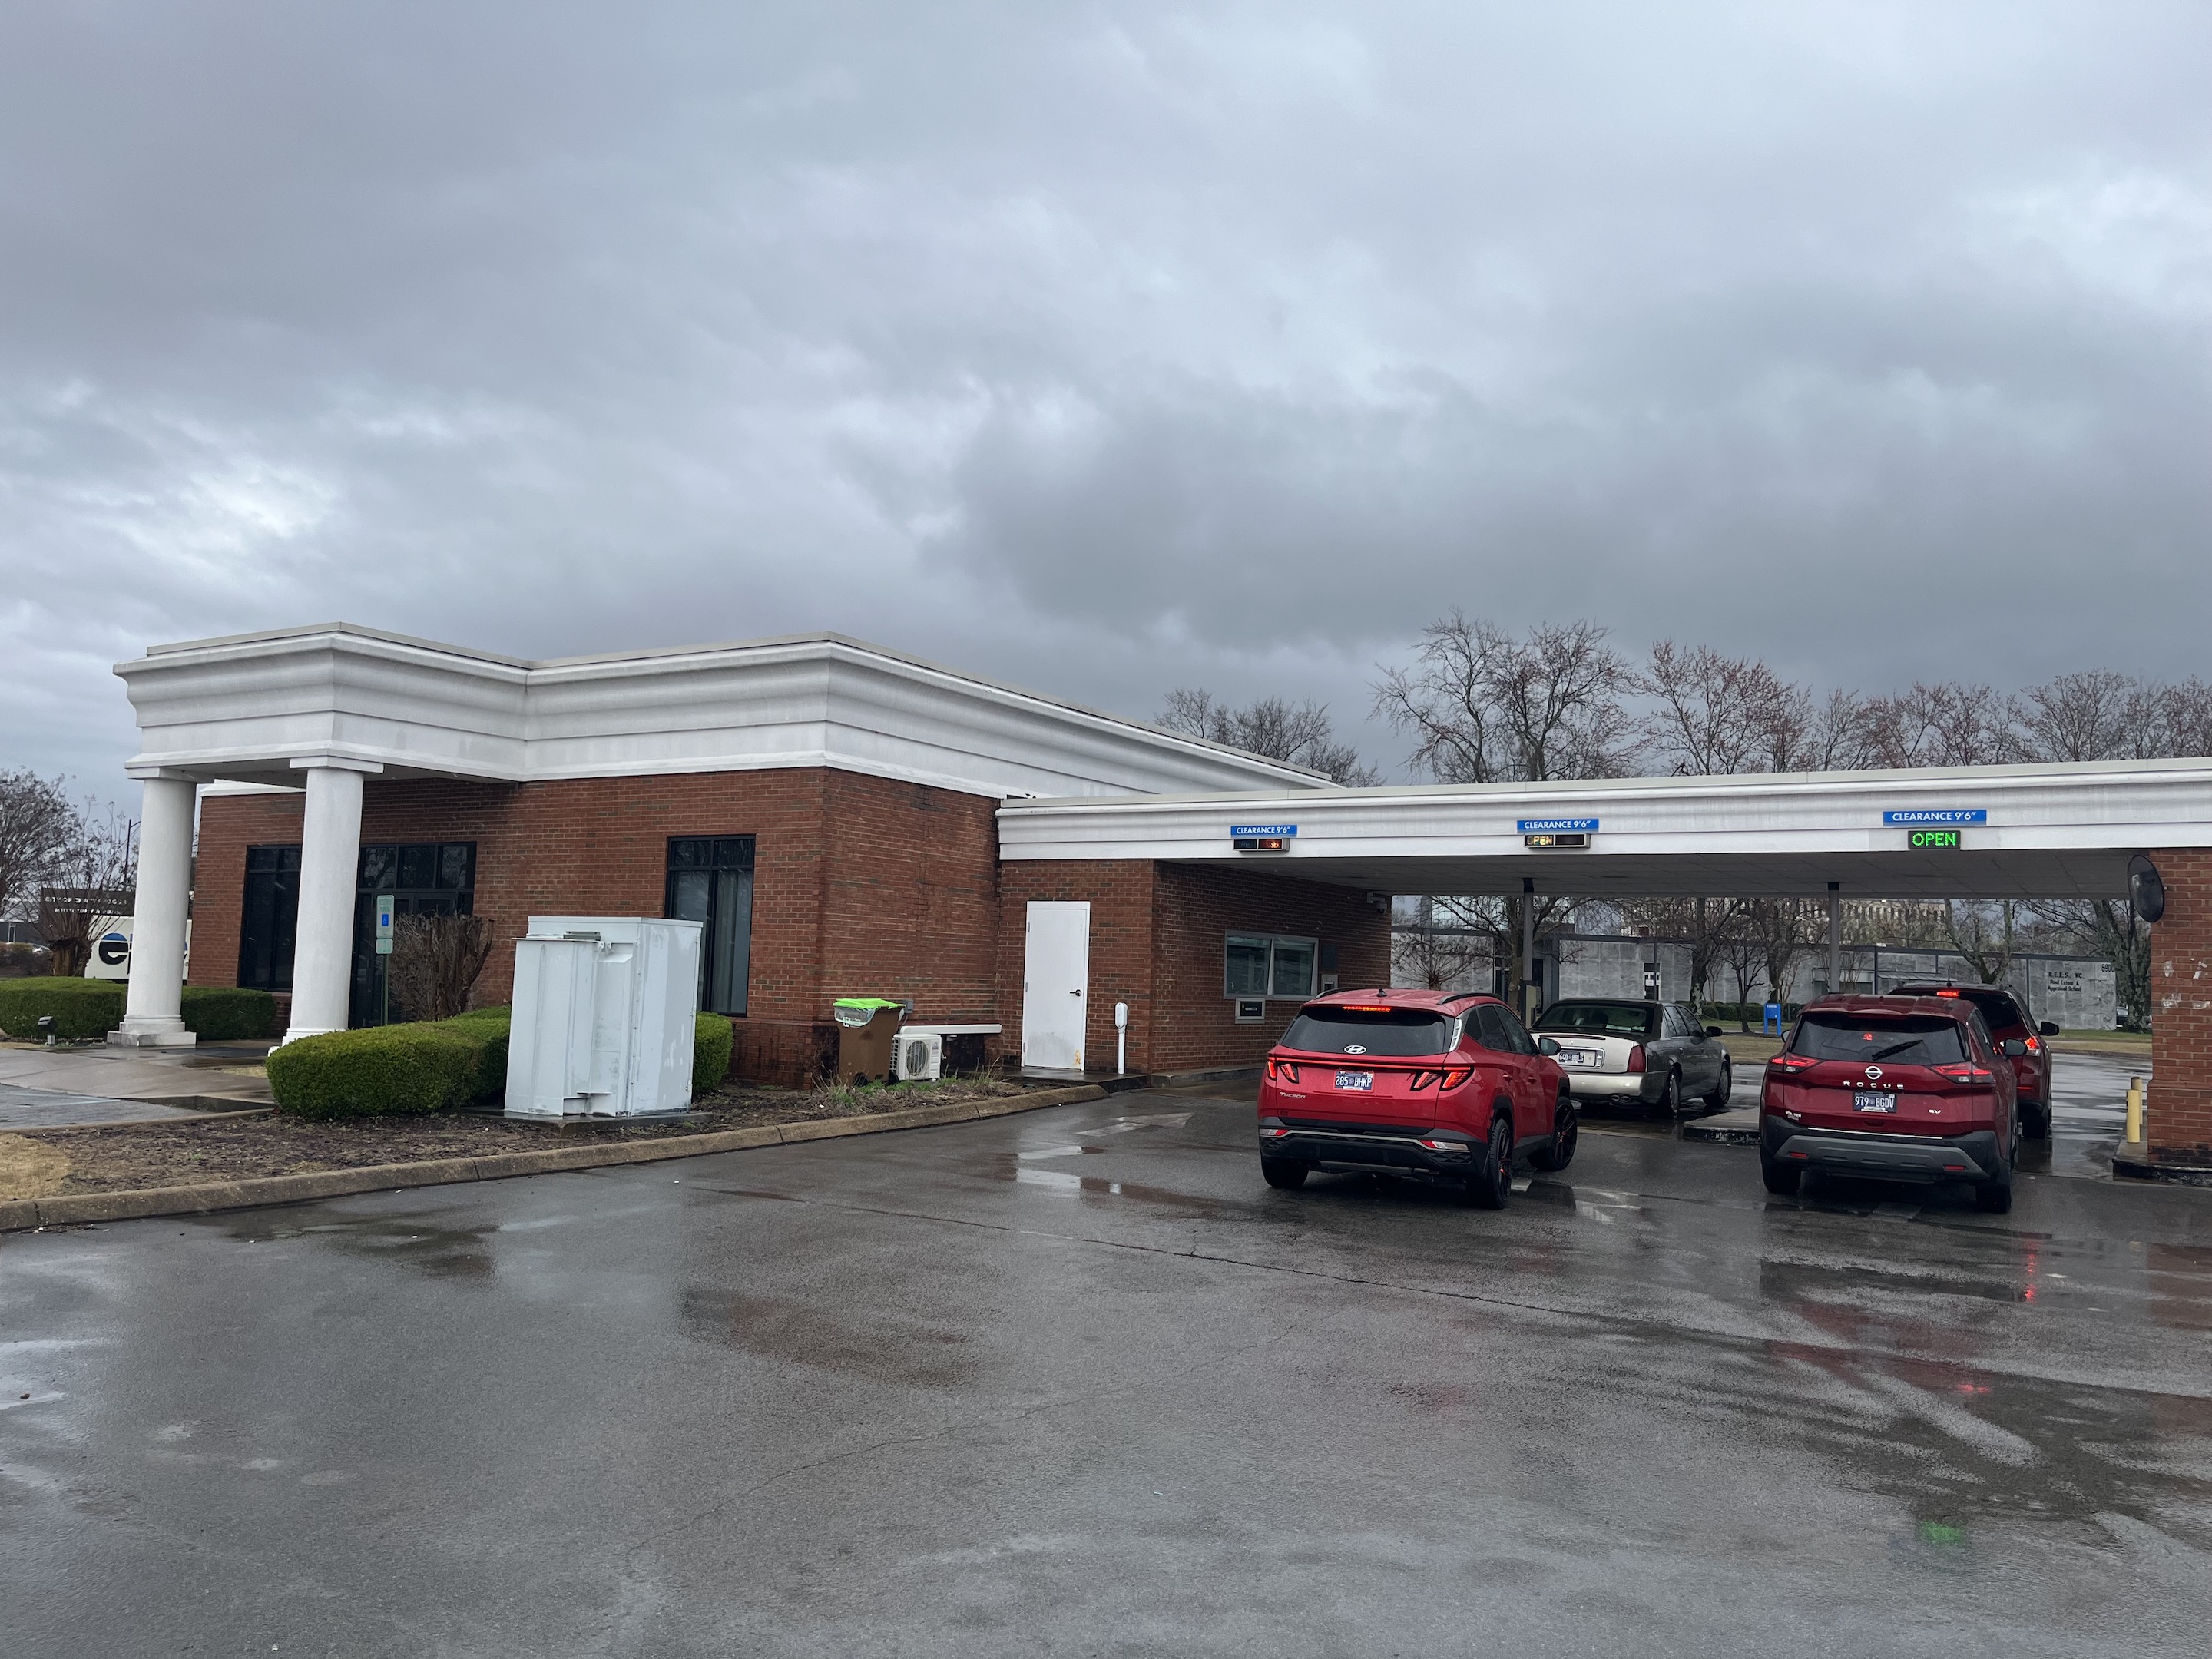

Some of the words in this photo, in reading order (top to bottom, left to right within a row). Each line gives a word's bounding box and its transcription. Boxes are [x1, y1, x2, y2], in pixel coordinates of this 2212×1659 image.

[1892, 812, 1952, 821] CLEARANCE
[1955, 811, 1976, 820] 9'6"
[1524, 820, 1571, 829] CLEARANCE
[1912, 833, 1955, 846] OPEN
[1335, 1075, 1349, 1086] 285
[1353, 1077, 1372, 1088] BHKP
[1843, 1081, 1904, 1090] ROGUE
[1855, 1096, 1869, 1106] 979
[1875, 1097, 1894, 1108] BGDV
